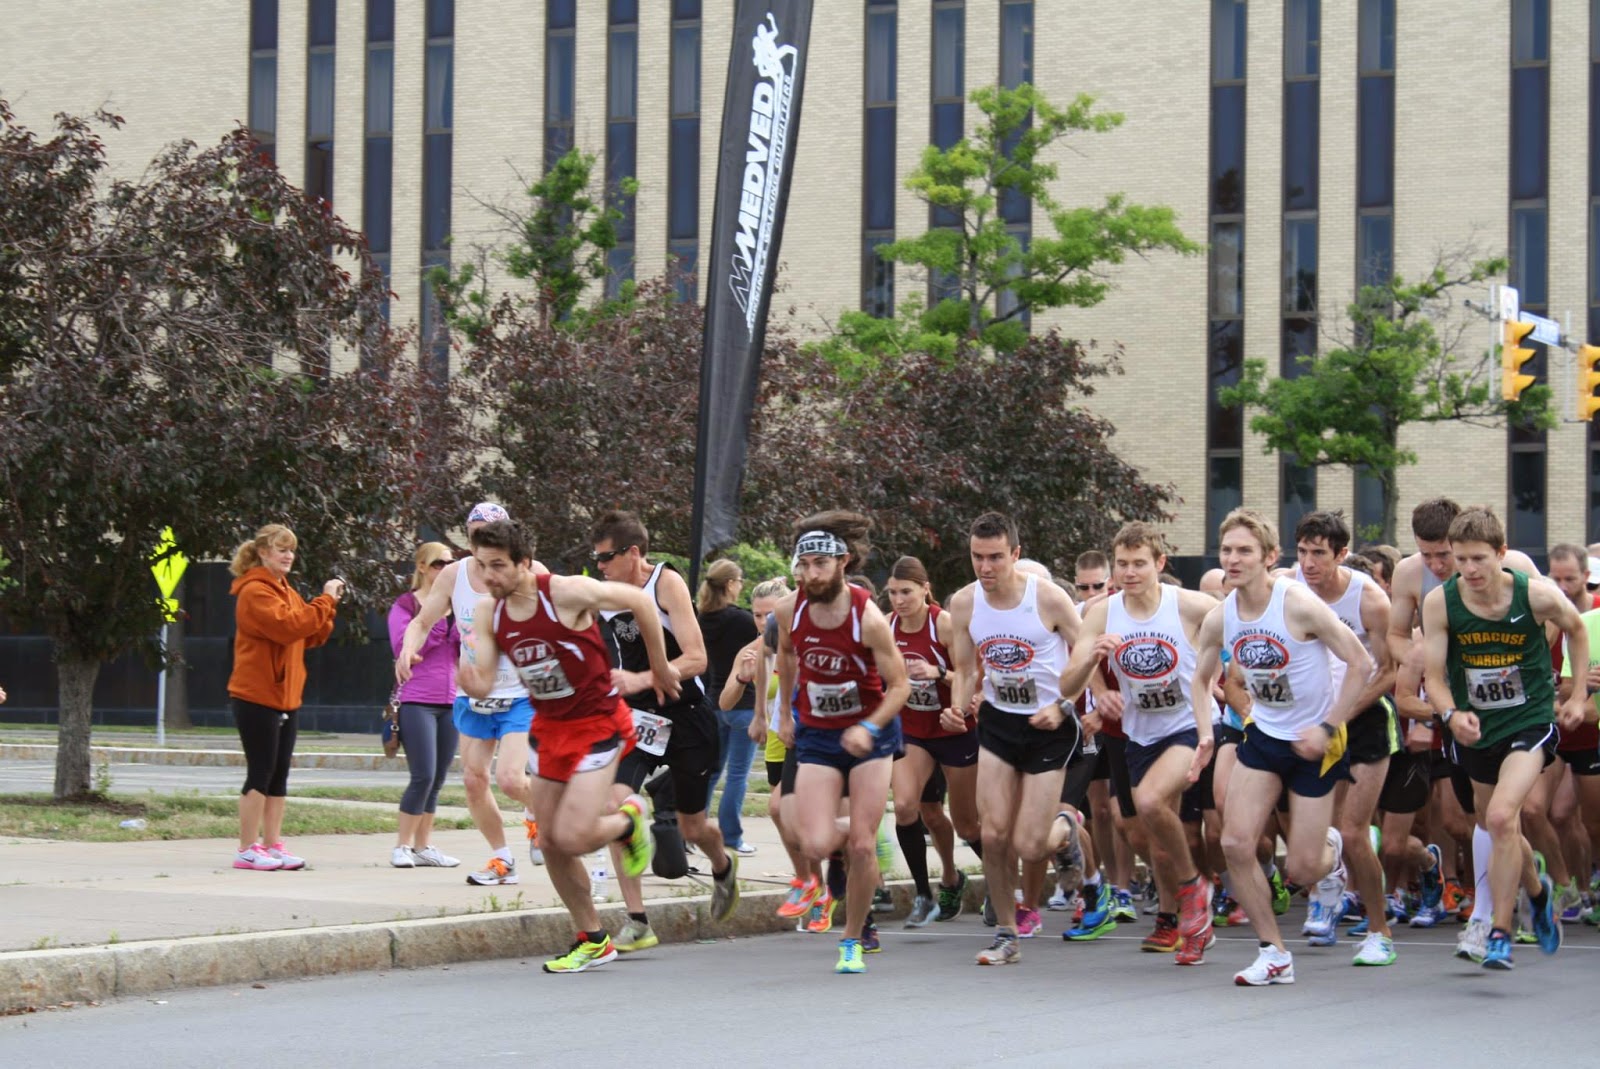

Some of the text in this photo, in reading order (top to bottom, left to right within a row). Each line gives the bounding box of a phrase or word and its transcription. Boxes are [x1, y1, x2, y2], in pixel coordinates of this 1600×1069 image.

[1150, 631, 1179, 647] RACING
[1259, 628, 1286, 644] RACING
[1456, 631, 1527, 645] SYRACUSE
[513, 644, 547, 662] GVH
[806, 653, 842, 670] GVH
[998, 685, 1031, 704] 509
[1138, 689, 1176, 709] 315
[1476, 680, 1516, 702] 486
[816, 696, 853, 712] 295
